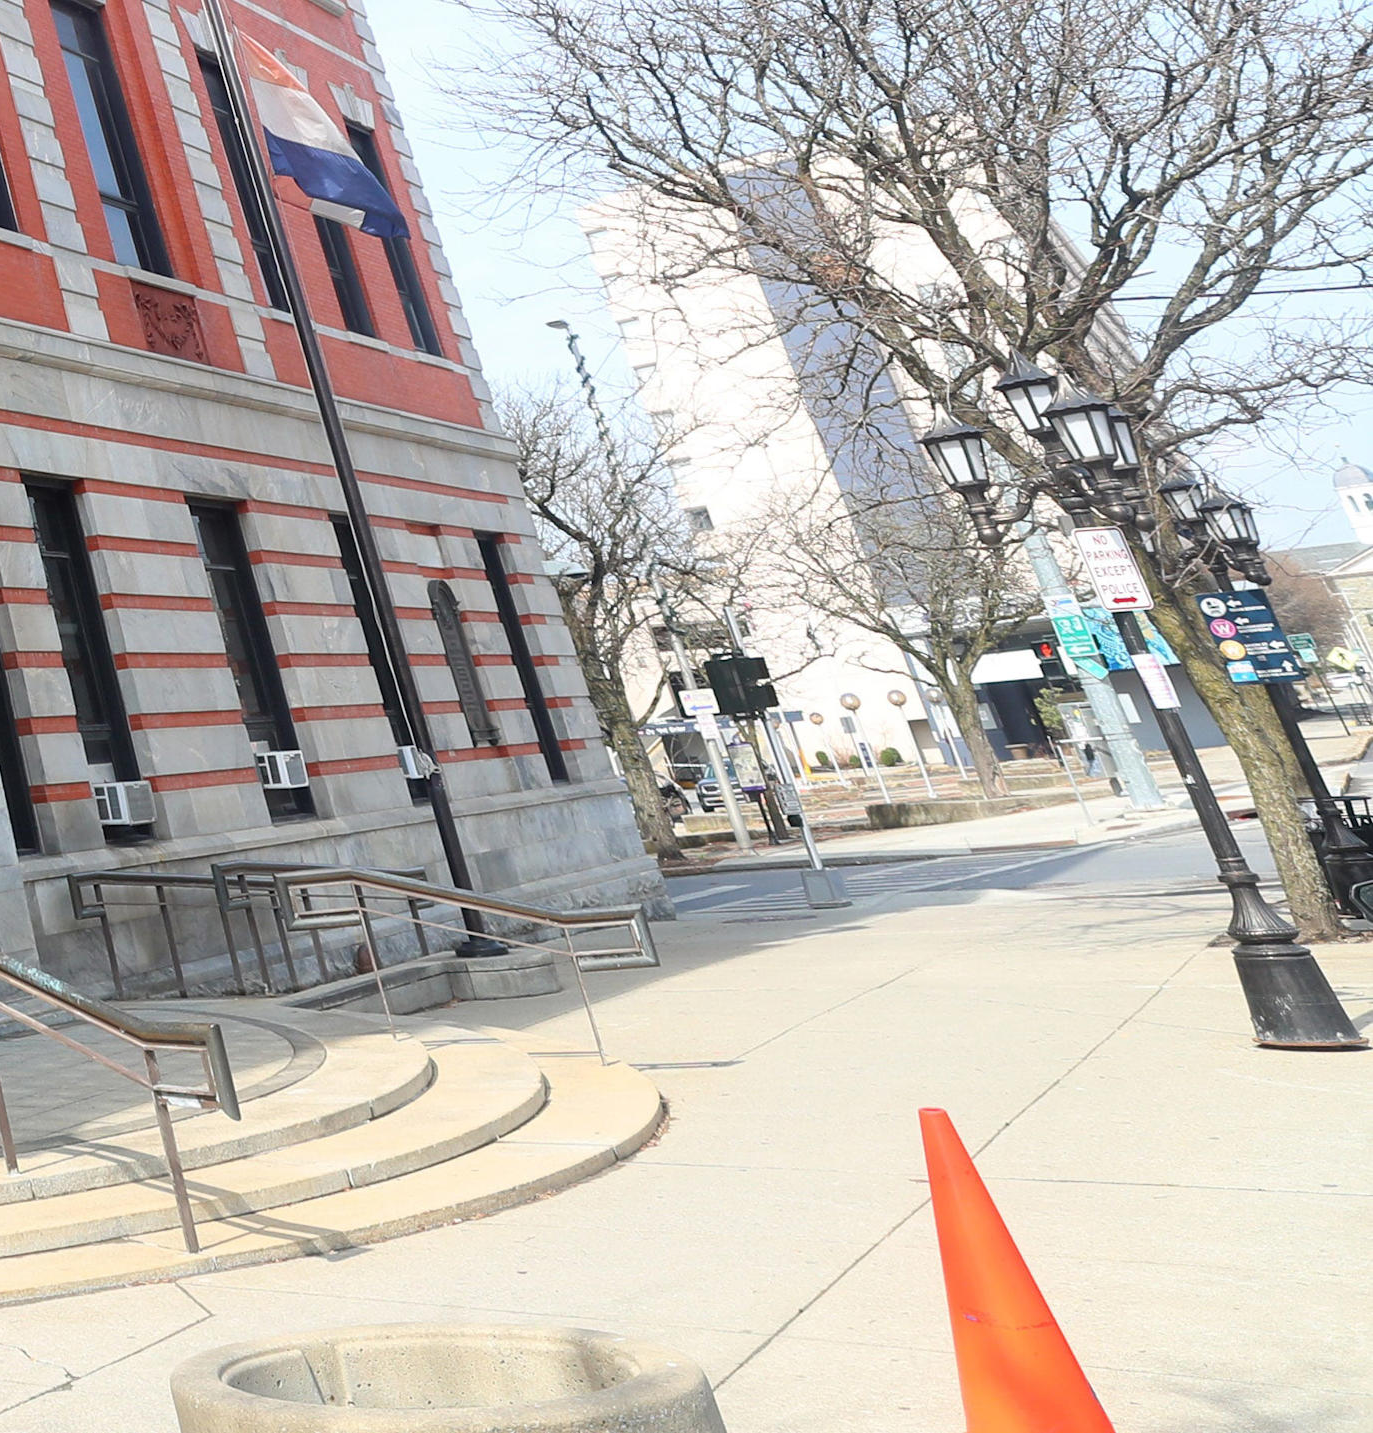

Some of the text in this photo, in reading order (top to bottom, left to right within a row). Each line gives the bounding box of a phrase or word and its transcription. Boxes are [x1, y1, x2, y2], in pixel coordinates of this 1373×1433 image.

[1092, 534, 1108, 545] NO
[1085, 549, 1128, 561] PARKING
[1094, 564, 1134, 577] EXCEPT
[1101, 583, 1142, 595] POLICE
